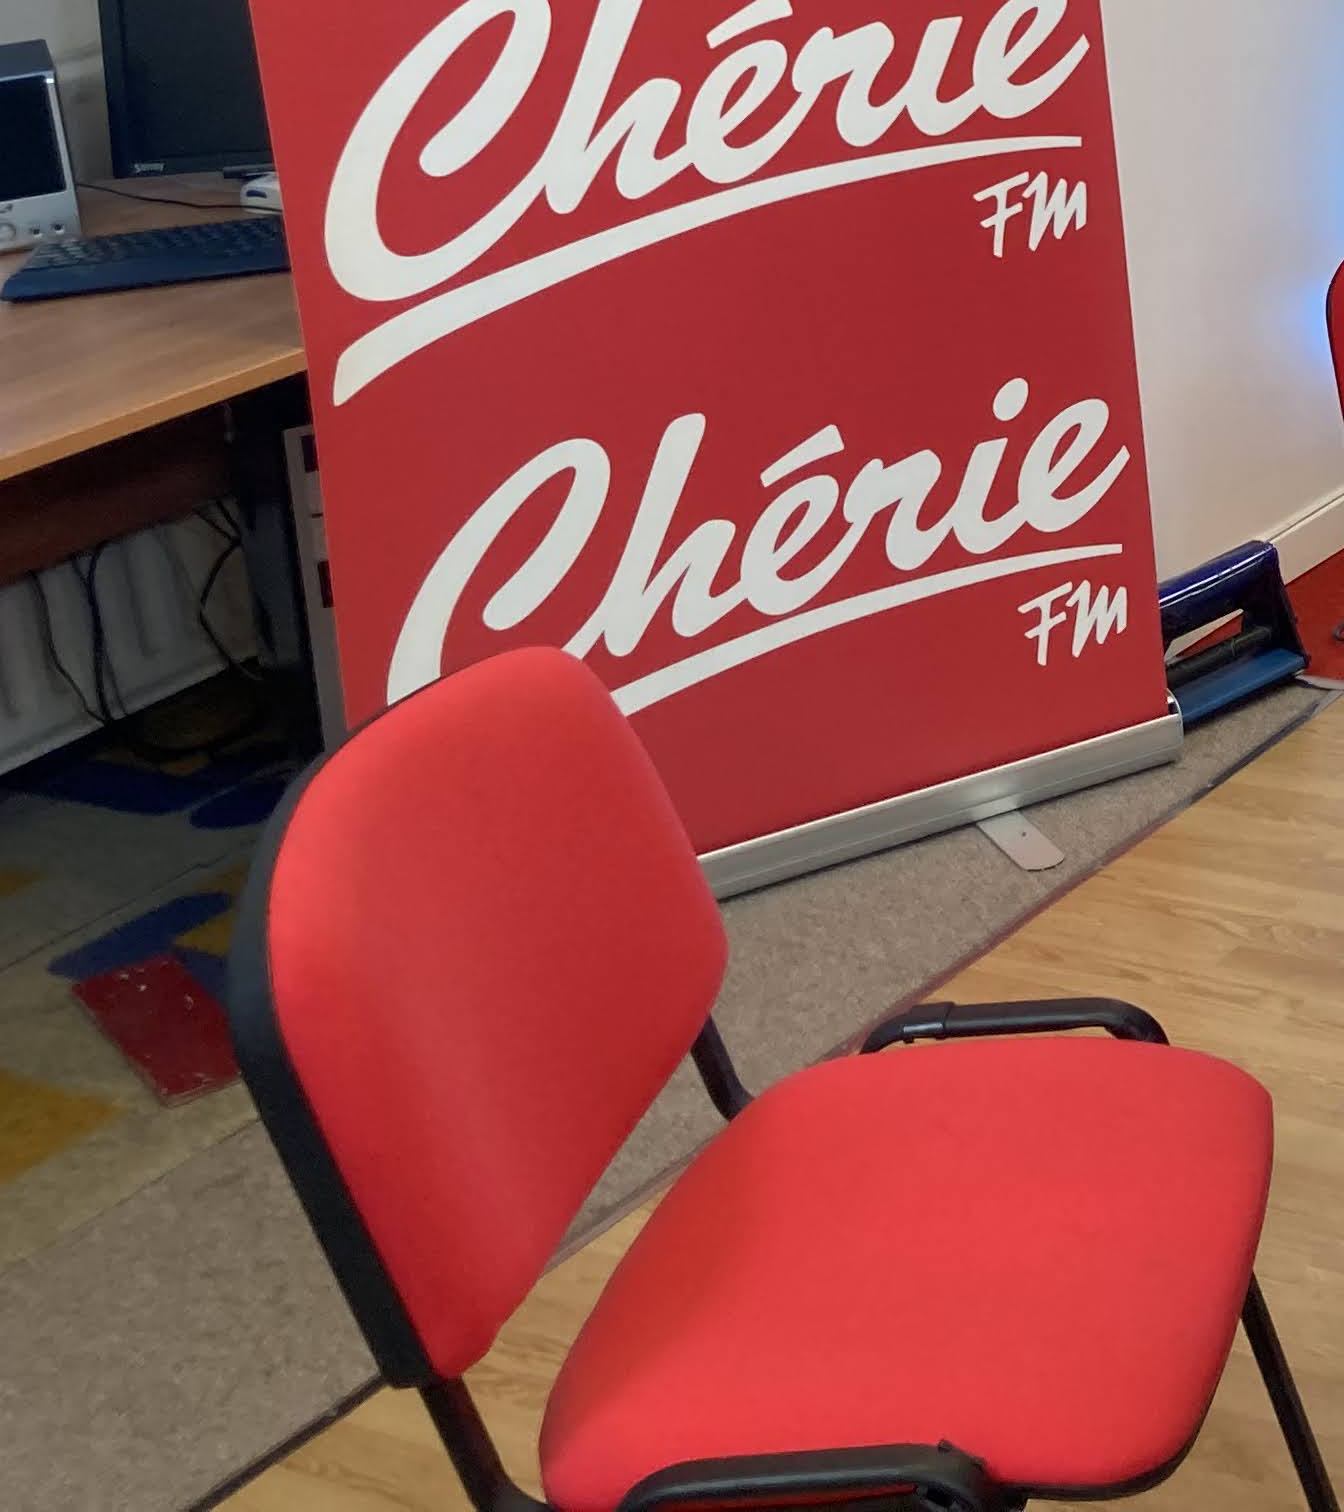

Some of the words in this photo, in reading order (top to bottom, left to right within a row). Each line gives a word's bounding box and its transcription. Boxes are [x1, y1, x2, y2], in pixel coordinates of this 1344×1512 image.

[973, 171, 1088, 257] FM
[388, 377, 1130, 705] Chérie
[1018, 580, 1127, 666] FM
